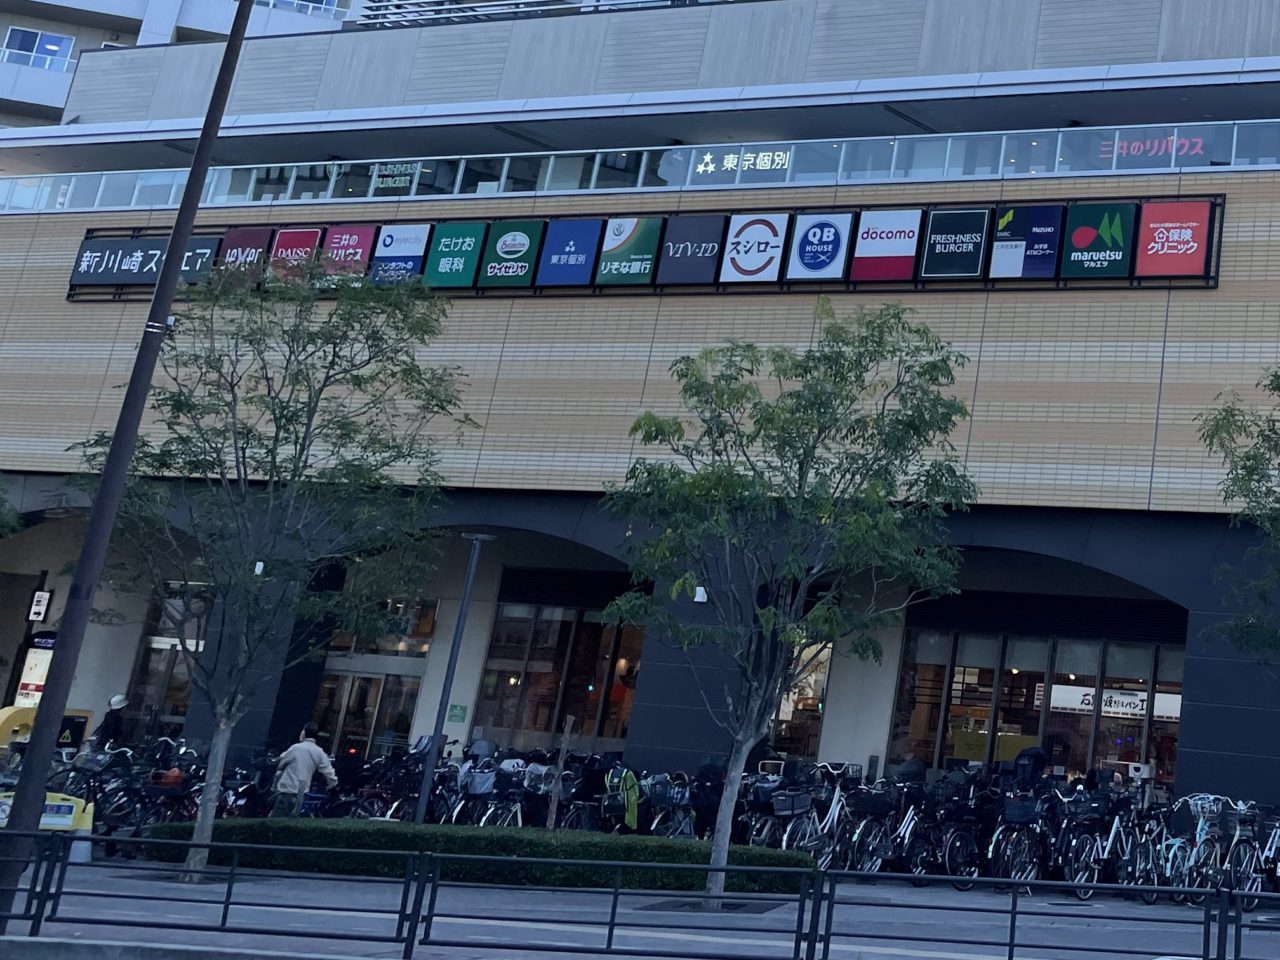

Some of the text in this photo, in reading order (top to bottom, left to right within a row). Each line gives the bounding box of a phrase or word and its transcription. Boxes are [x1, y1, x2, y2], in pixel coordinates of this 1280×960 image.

[721, 151, 790, 171] 東京個別
[331, 234, 359, 247] 三井の
[807, 227, 836, 244] QB
[861, 227, 915, 241] docomo
[930, 233, 982, 244] FRESHNESS
[1168, 228, 1193, 242] 保険
[438, 237, 475, 252] たけお
[728, 240, 781, 255] スシロー
[805, 244, 833, 252] HOUSE
[935, 242, 974, 254] BURGER
[1147, 241, 1198, 255] クリニック
[550, 253, 586, 266] 東京個別
[1071, 250, 1122, 261] maruetsu
[438, 257, 464, 273] 眼科
[487, 262, 529, 277] サイゼリヤ
[600, 260, 652, 275] りそな銀行
[1083, 260, 1108, 268] マルエツ
